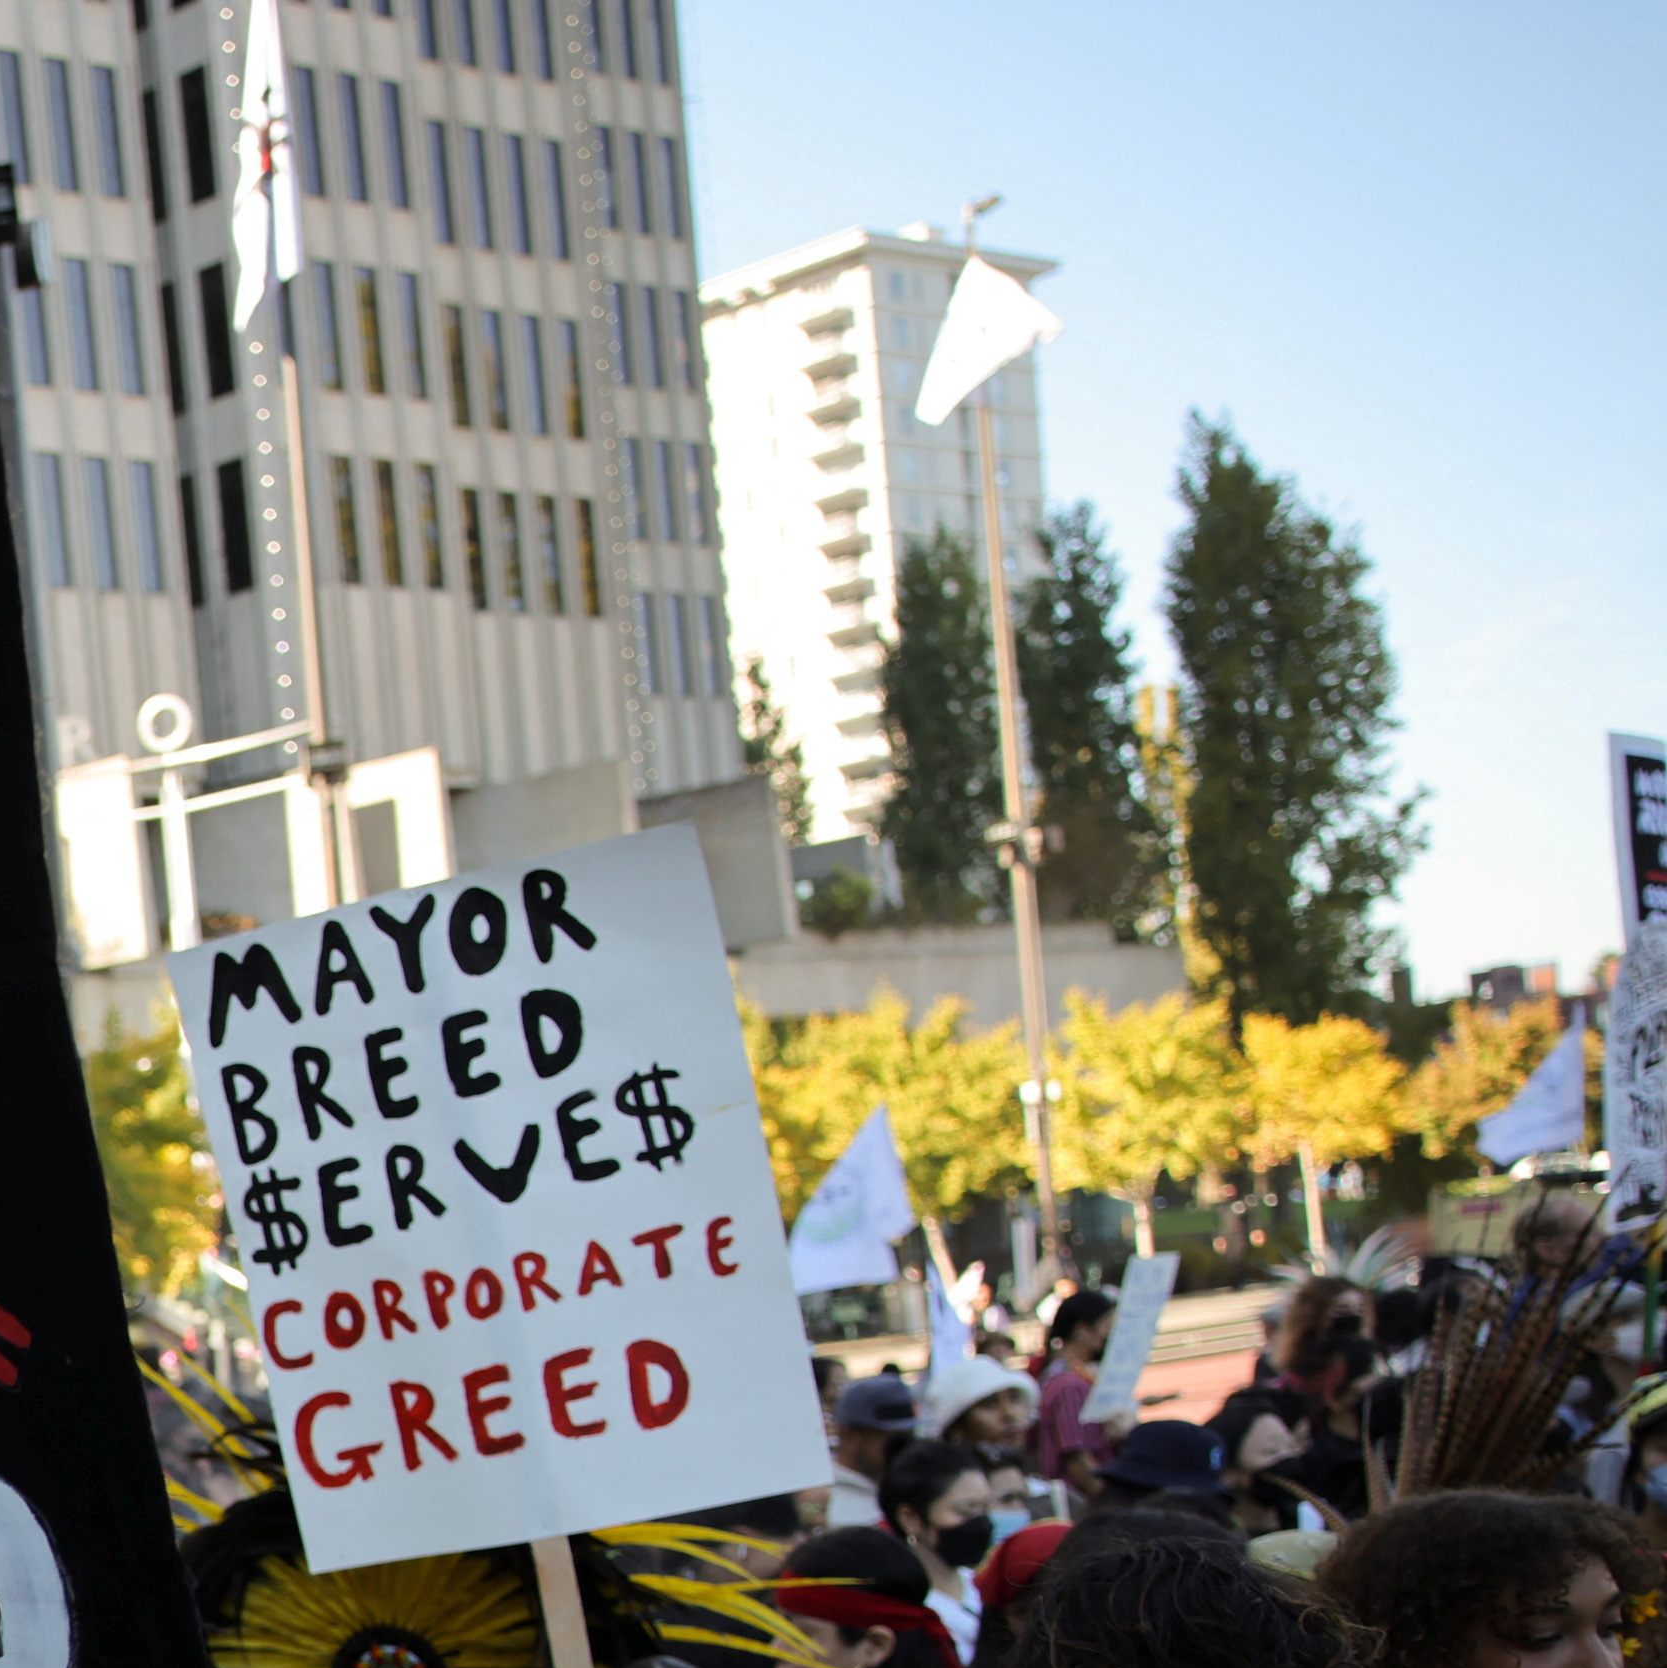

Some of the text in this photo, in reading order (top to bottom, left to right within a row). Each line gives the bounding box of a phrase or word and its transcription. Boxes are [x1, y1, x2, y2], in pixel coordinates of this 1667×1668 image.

[208, 868, 598, 1049] MAYOR
[221, 988, 585, 1166] BREED
[243, 1063, 696, 1275] $ERVE$
[262, 1216, 742, 1371] CORPORATE
[293, 1338, 691, 1490] GREED
